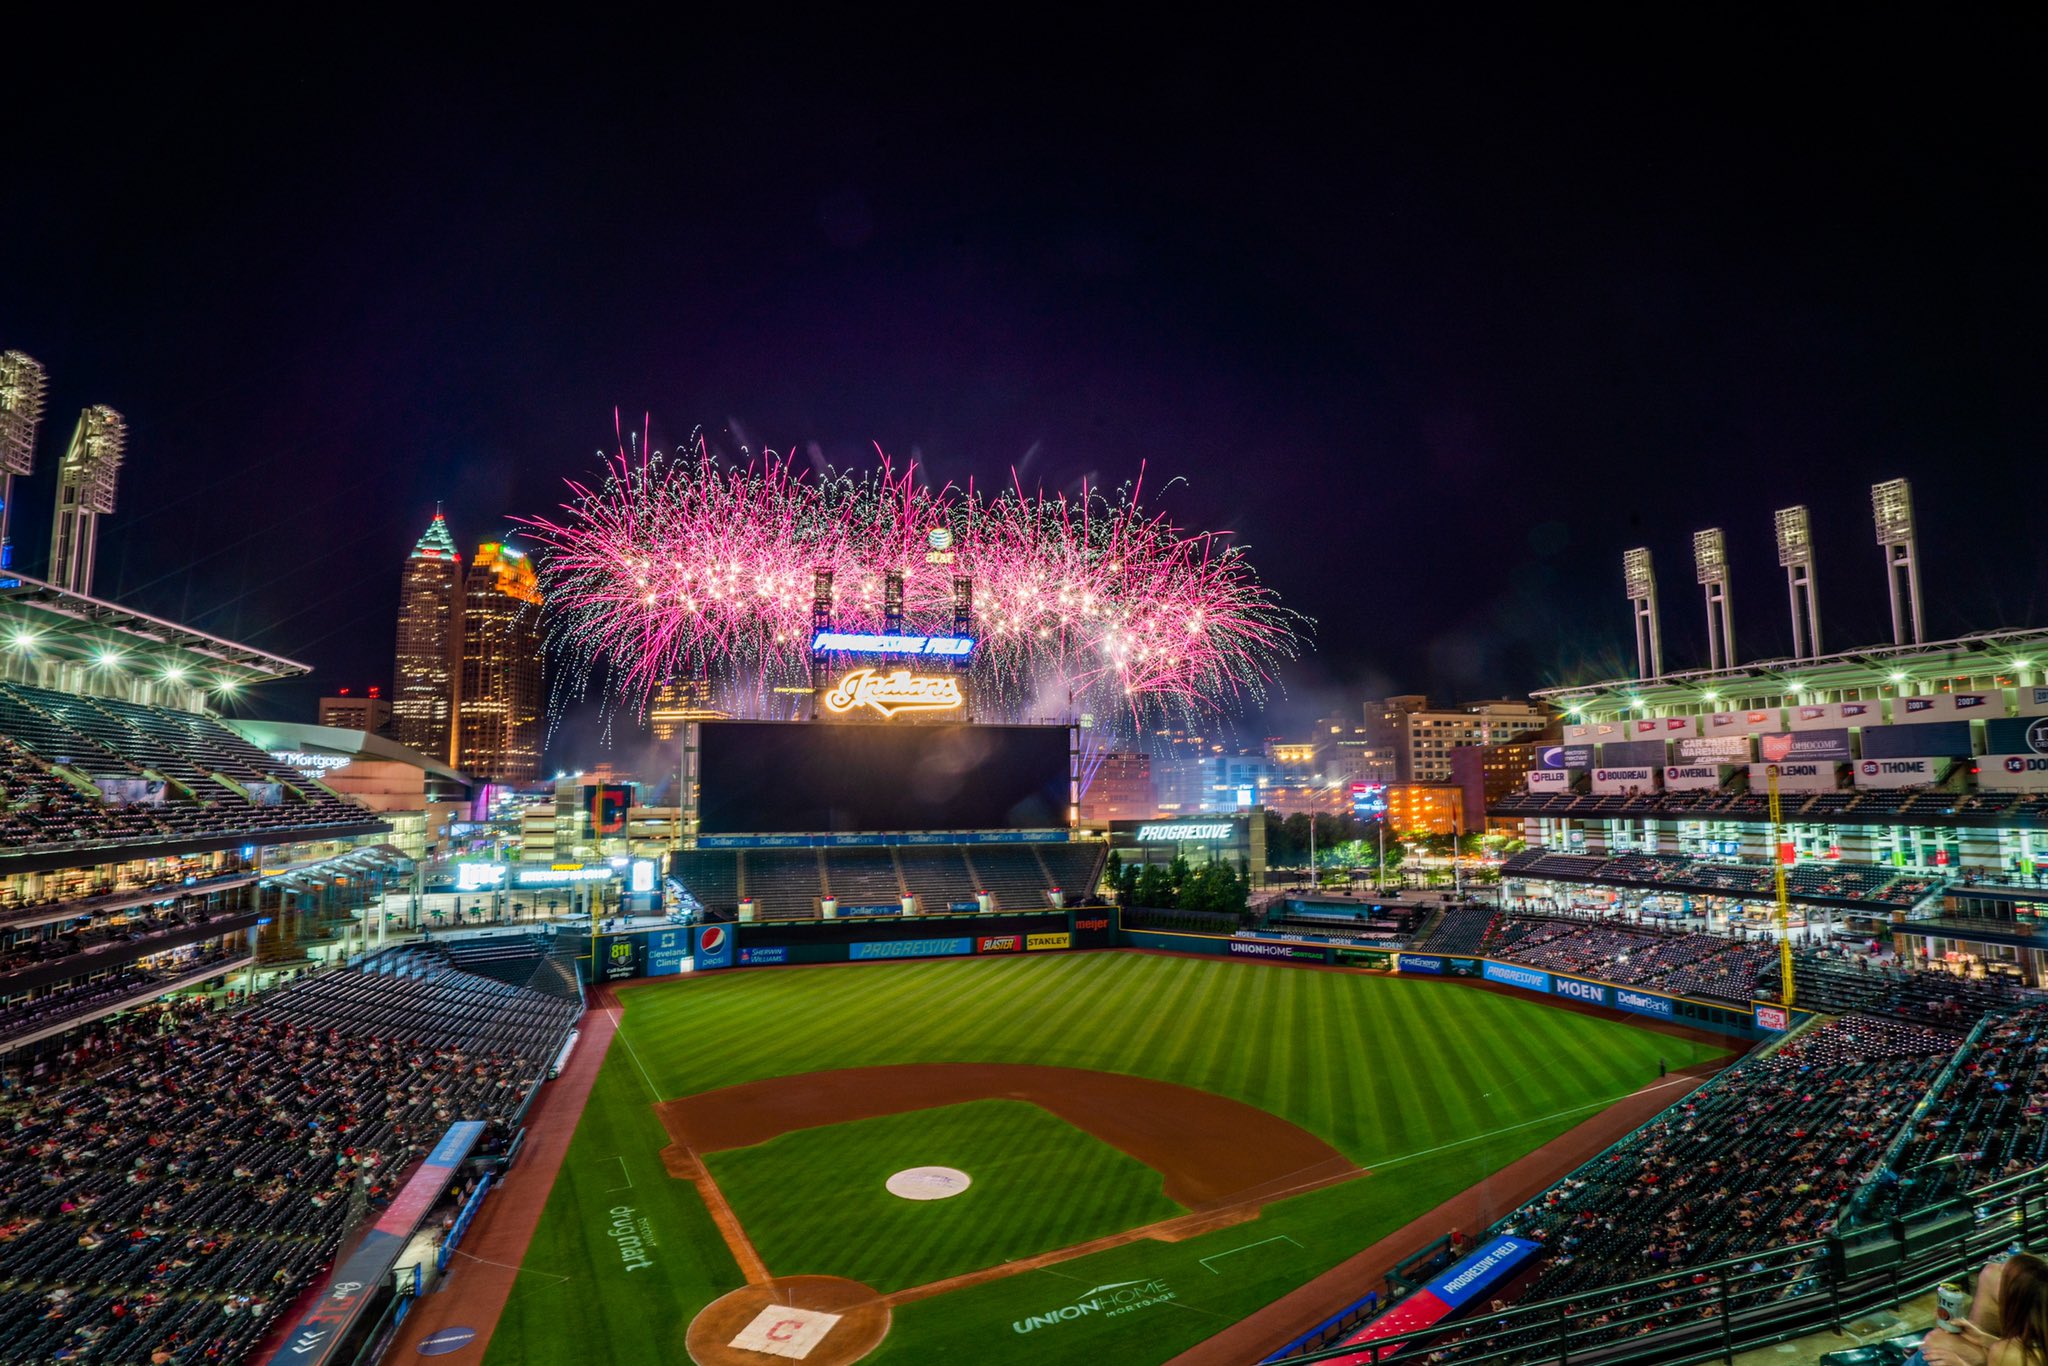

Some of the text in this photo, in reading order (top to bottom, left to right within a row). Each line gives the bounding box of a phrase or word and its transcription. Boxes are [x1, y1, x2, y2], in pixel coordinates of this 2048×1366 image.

[826, 669, 962, 717] Indians
[1908, 702, 1924, 710] 2001
[1958, 698, 1975, 706] 2007
[1843, 706, 1858, 714] 1999
[1680, 746, 1743, 757] WAREHOUSE
[287, 752, 350, 769] Mortgage
[2007, 760, 2019, 770] 14
[1680, 768, 1715, 777] AVERILL
[1781, 765, 1817, 776] LEMON
[1864, 761, 1925, 774] 25 THOME
[1541, 772, 1565, 781] FELLER
[1607, 770, 1648, 780] BOUDREAU
[1137, 823, 1234, 841] PROGRESSIVE
[1076, 919, 1108, 931] meijer
[983, 938, 1016, 950] BLASTER
[1028, 937, 1068, 946] STANLEY
[1235, 930, 1402, 949] MOEN MOEN MOEN MOEN
[611, 943, 630, 958] 811
[649, 948, 687, 958] Cleveland
[751, 948, 782, 956] SHERWIN
[861, 939, 959, 957] PROGRESSIVE
[656, 959, 679, 967] Clinic
[703, 957, 724, 966] pepsi
[1400, 956, 1441, 969] FirstEnergy
[1487, 965, 1544, 986] PROGRESSIVE
[1556, 979, 1603, 1001] MOEN
[1617, 991, 1670, 1012] DollarBank
[1757, 1008, 1780, 1022] drug
[1760, 1019, 1786, 1029] mart
[608, 1206, 653, 1271] drug mart
[1442, 1241, 1518, 1294] PROGRESSIVE FIELD
[1105, 1292, 1177, 1318] MORTGAGE
[767, 1320, 804, 1341] C
